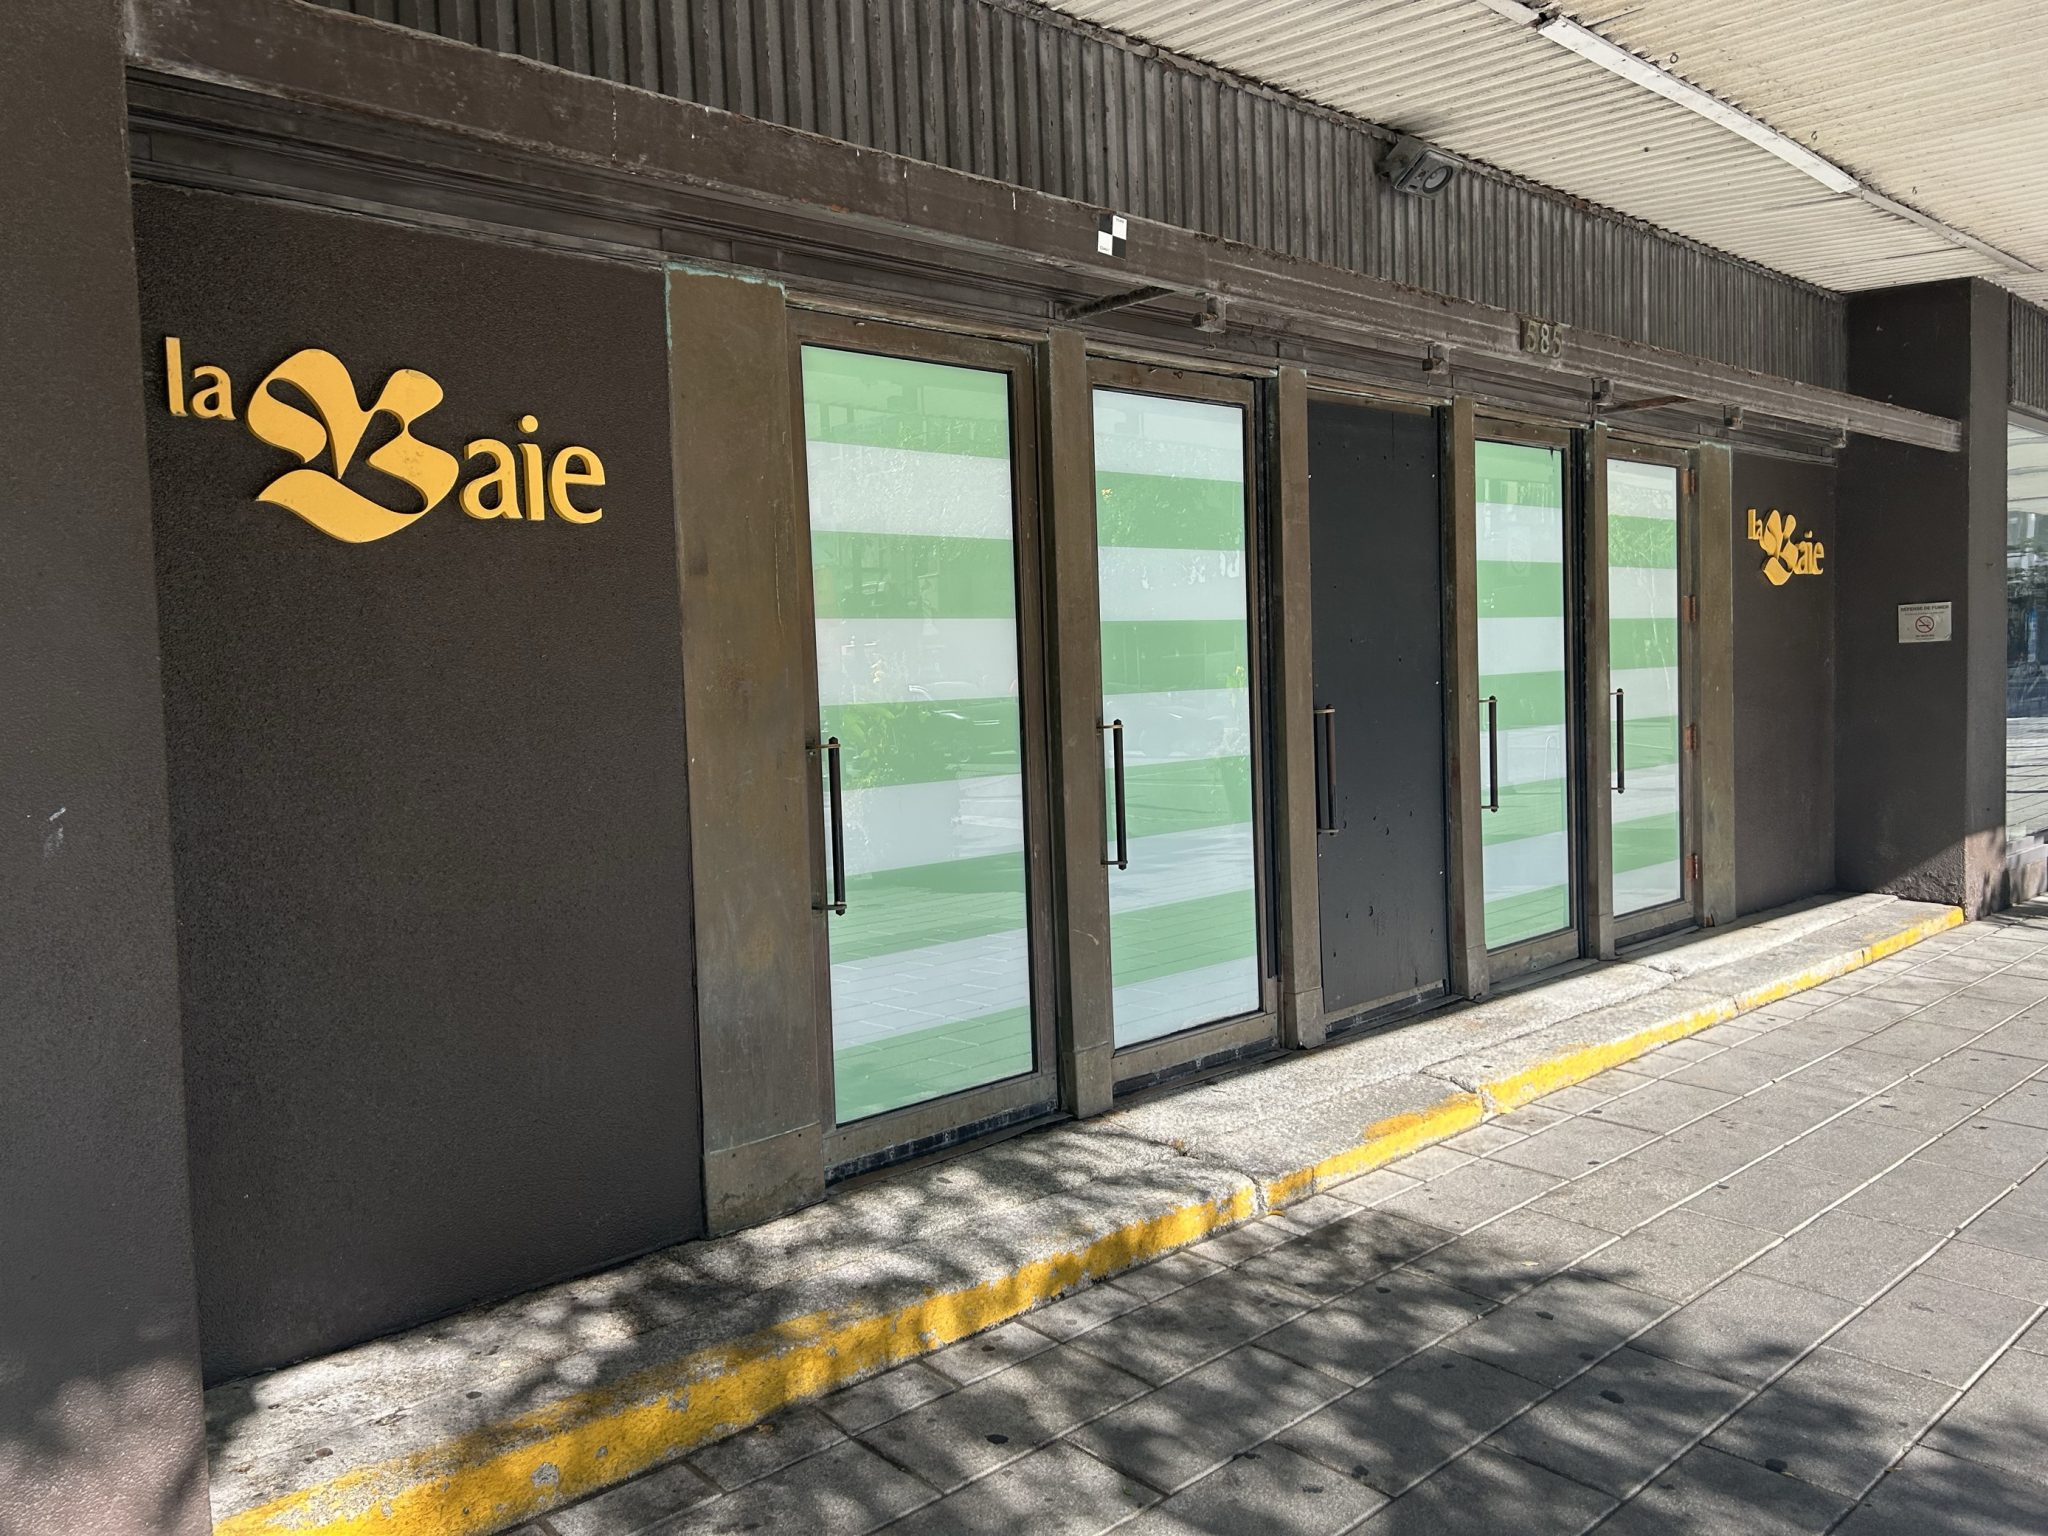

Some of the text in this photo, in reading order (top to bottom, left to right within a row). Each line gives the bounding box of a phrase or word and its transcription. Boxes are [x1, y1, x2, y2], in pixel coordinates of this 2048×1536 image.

[1526, 320, 1562, 358] 585
[164, 336, 606, 544] la Baie
[1747, 509, 1824, 586] la Baie
